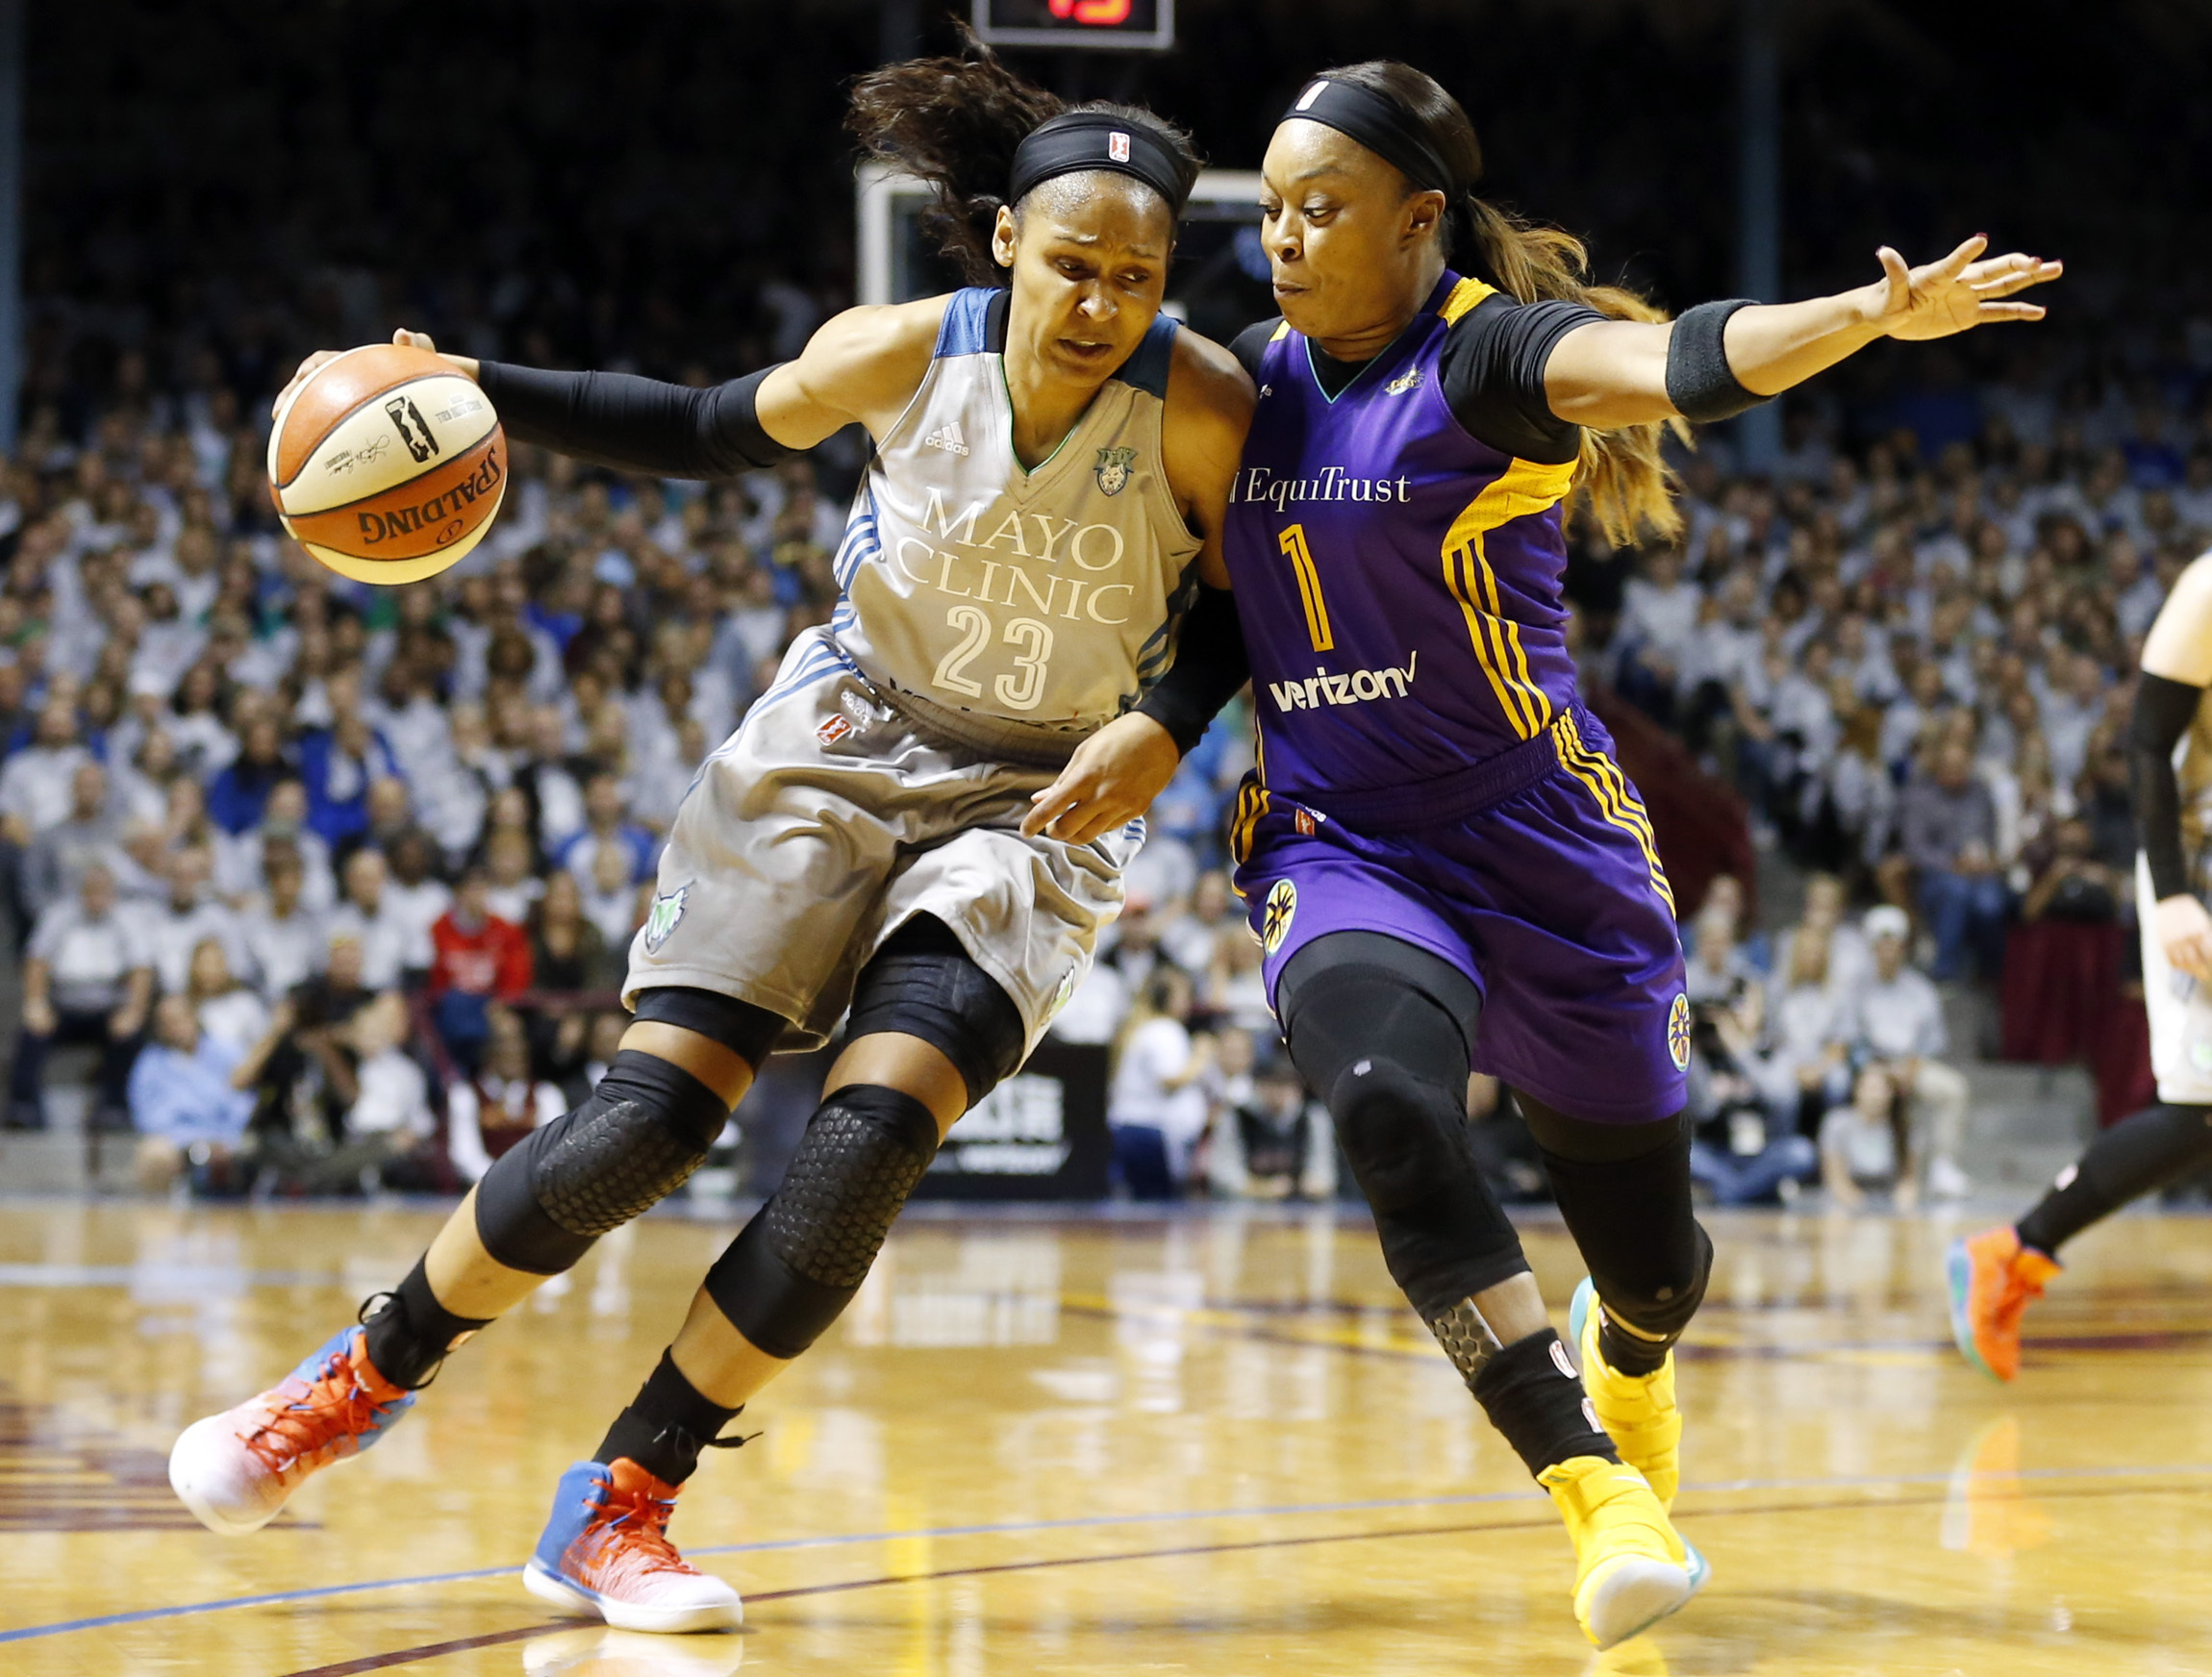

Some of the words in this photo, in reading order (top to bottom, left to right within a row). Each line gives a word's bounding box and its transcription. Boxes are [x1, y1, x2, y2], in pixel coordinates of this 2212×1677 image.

[925, 433, 969, 457] adidas
[358, 446, 501, 545] SPALDING
[917, 486, 1124, 572] MAYO
[1244, 466, 1412, 513] EquiTrust
[895, 536, 1135, 625] CLINIC
[1278, 524, 1335, 653] 1
[931, 605, 1054, 711] 23
[1269, 666, 1408, 713] verizon
